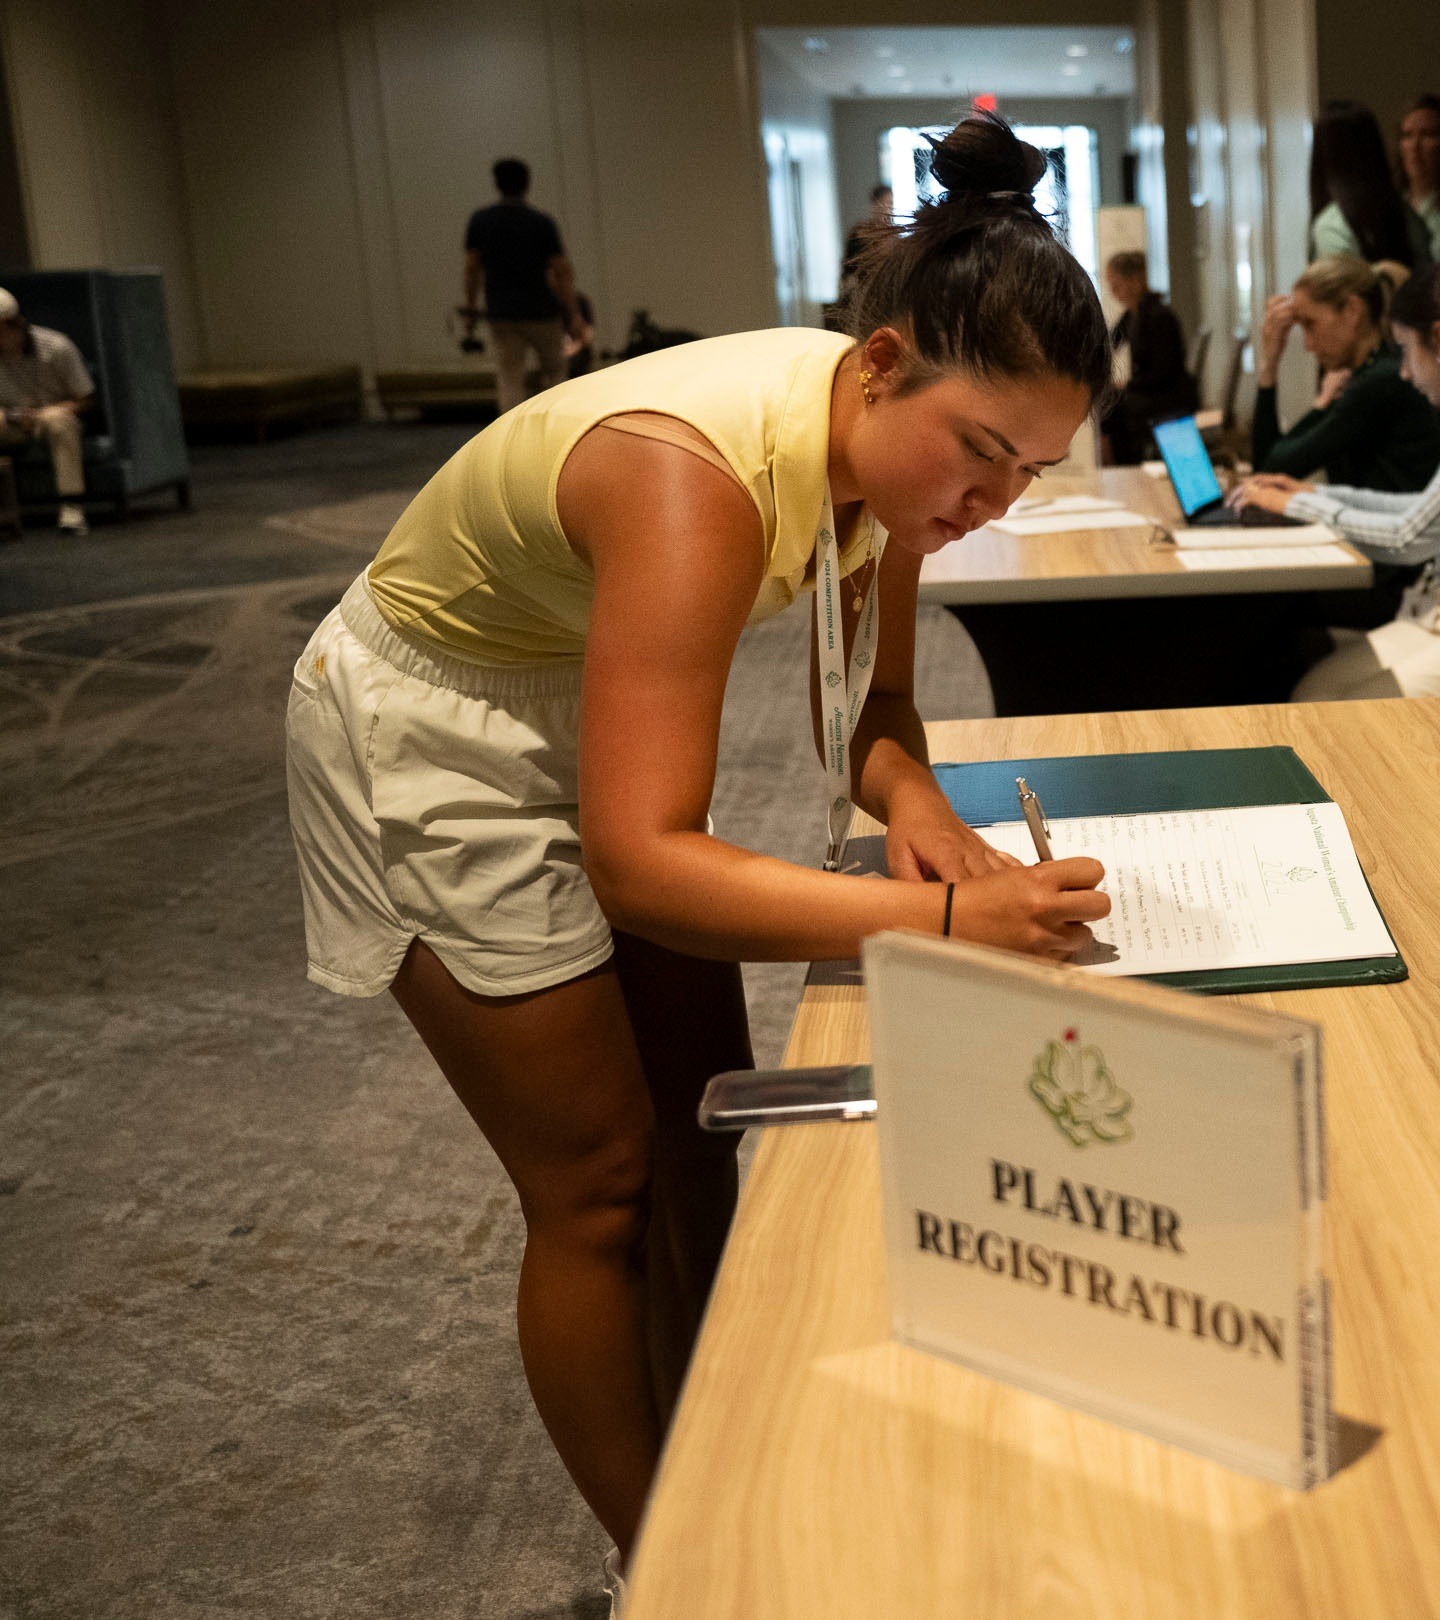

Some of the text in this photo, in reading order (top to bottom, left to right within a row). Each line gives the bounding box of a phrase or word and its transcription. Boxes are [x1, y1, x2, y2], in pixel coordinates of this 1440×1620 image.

[825, 576, 834, 629] COMPETITION
[827, 629, 835, 650] AREA
[1313, 825, 1329, 850] National
[1320, 849, 1337, 876] Women's
[1328, 876, 1343, 898] Amateur
[990, 1156, 1187, 1256] PLAYER
[914, 1207, 1286, 1365] REGISTRATION
